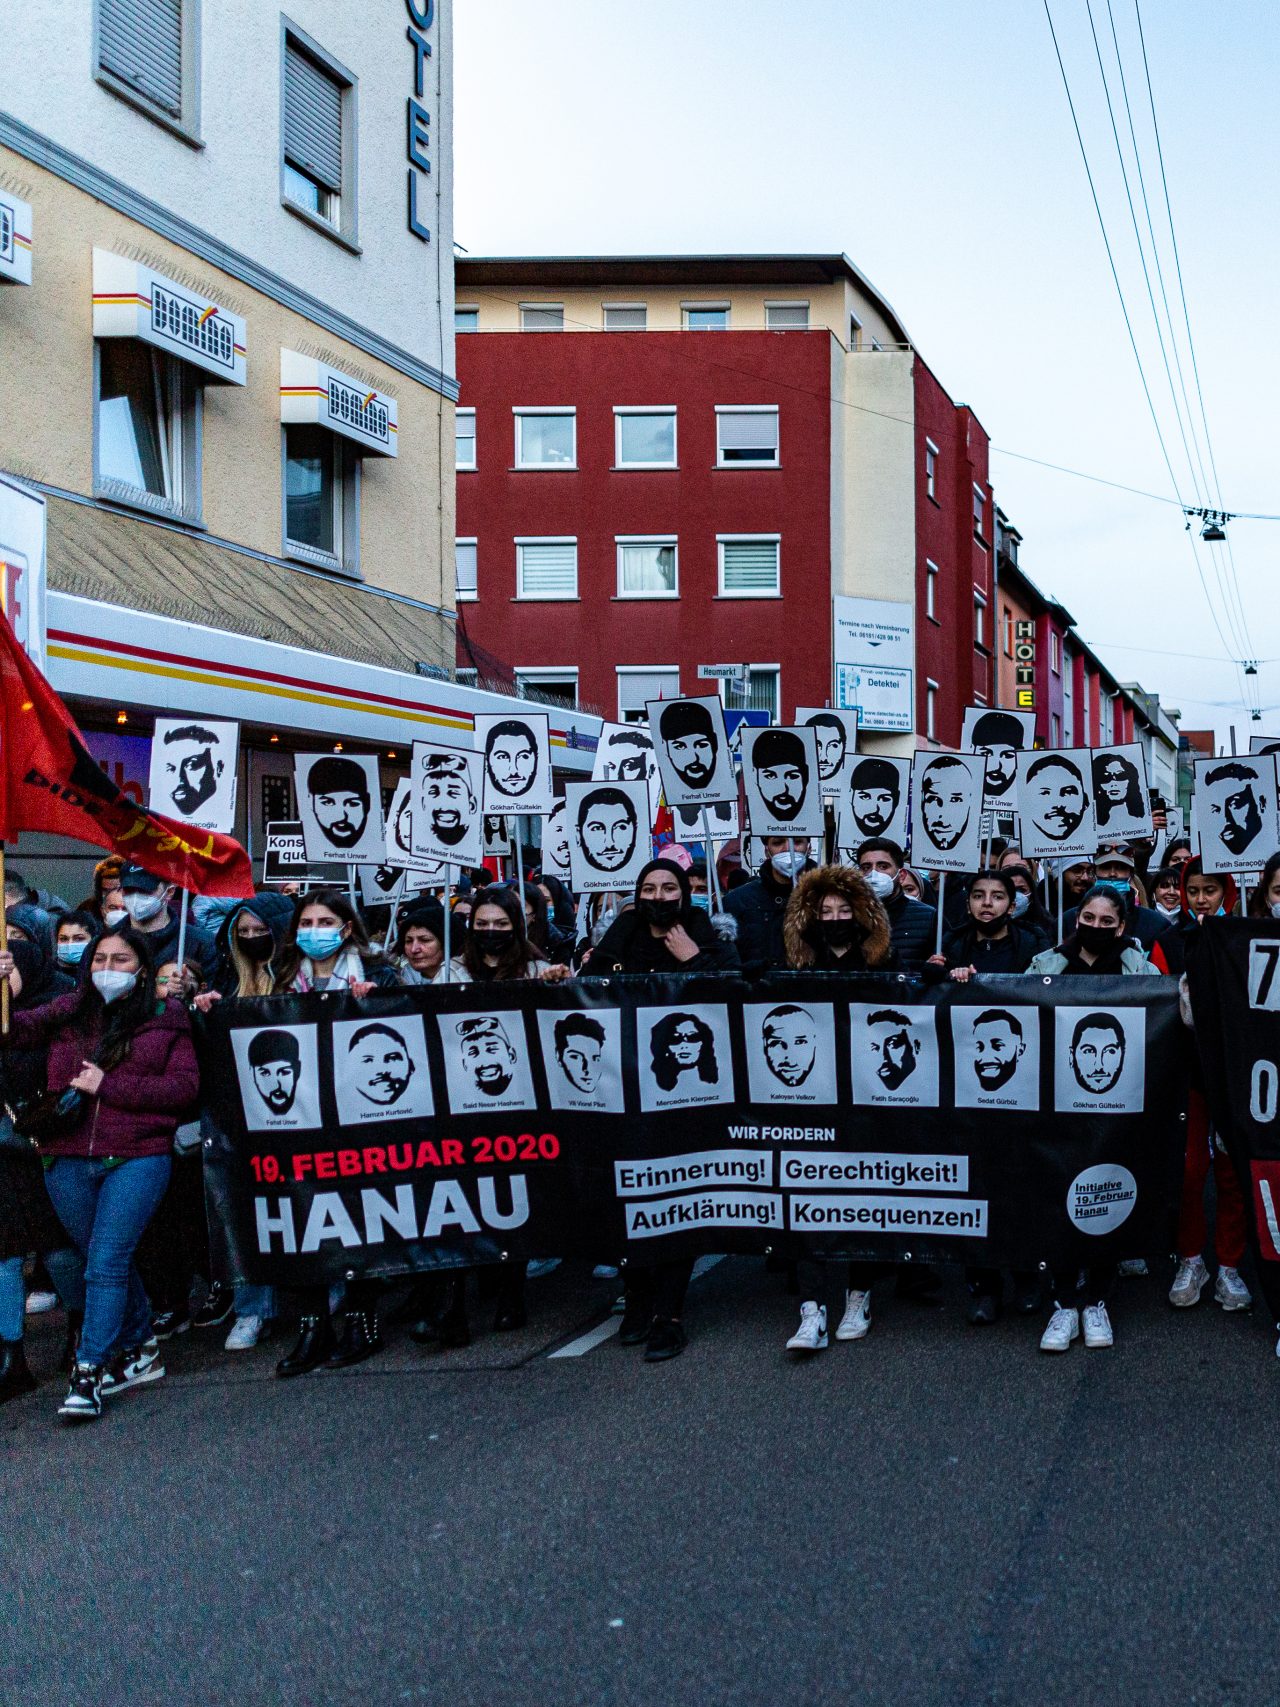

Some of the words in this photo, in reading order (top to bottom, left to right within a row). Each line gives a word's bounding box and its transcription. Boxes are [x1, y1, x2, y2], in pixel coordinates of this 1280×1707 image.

[838, 619, 860, 628] Termine
[875, 623, 910, 633] Vereinbarung
[1017, 622, 1033, 706] HOTE
[703, 667, 737, 677] Heumarkt
[868, 678, 900, 689] Detektei
[681, 793, 702, 801] Ferhat
[703, 791, 721, 799] Unvar
[515, 803, 542, 811] Gültekin
[1097, 832, 1121, 840] ercedes
[1122, 828, 1147, 837] Kierpacz
[269, 836, 304, 848] Kons
[415, 845, 430, 855] Said
[430, 849, 449, 858] Nesar
[449, 853, 477, 863] Hashemi
[1034, 846, 1057, 854] Hamza
[1058, 843, 1085, 852] Kurtović
[323, 851, 346, 859] Ferhat
[347, 851, 368, 860] Unvar
[387, 857, 406, 866] Gökhan
[407, 858, 429, 868] Gültekin
[922, 856, 944, 867] Kaloyan
[945, 859, 966, 868] Velkov
[1215, 860, 1233, 869] Fatih
[584, 880, 612, 888] Gökhan
[612, 879, 638, 887] Gülteki
[656, 1096, 690, 1107] Mercedes
[690, 1094, 720, 1103] Kierpacz
[770, 1093, 795, 1101] Kaloyan
[796, 1093, 816, 1101] Velkov
[871, 1095, 887, 1103] Fatih
[977, 1097, 995, 1105] Sedat
[996, 1097, 1018, 1106] Gürbüz
[1072, 1101, 1097, 1109] Gökhan
[1098, 1101, 1126, 1109] Gültekin
[360, 1110, 384, 1119] Hamza
[384, 1107, 413, 1117] Kurtović
[727, 1125, 759, 1141] WIR
[761, 1126, 836, 1142] FORDERN
[250, 1154, 286, 1183] 19.
[292, 1140, 466, 1181] FEBRUAR
[473, 1133, 560, 1164] 2020
[620, 1158, 767, 1189] Erinnerung!
[785, 1159, 958, 1186] Gerechtigkeit!
[1075, 1181, 1123, 1192] Initiative
[1076, 1196, 1092, 1205] 19.
[1094, 1190, 1135, 1202] Februar
[254, 1173, 532, 1254] HANAU
[631, 1198, 777, 1231] Aufklärung!
[794, 1202, 982, 1229] Konsequenzen!
[1075, 1205, 1109, 1217] Hanau
